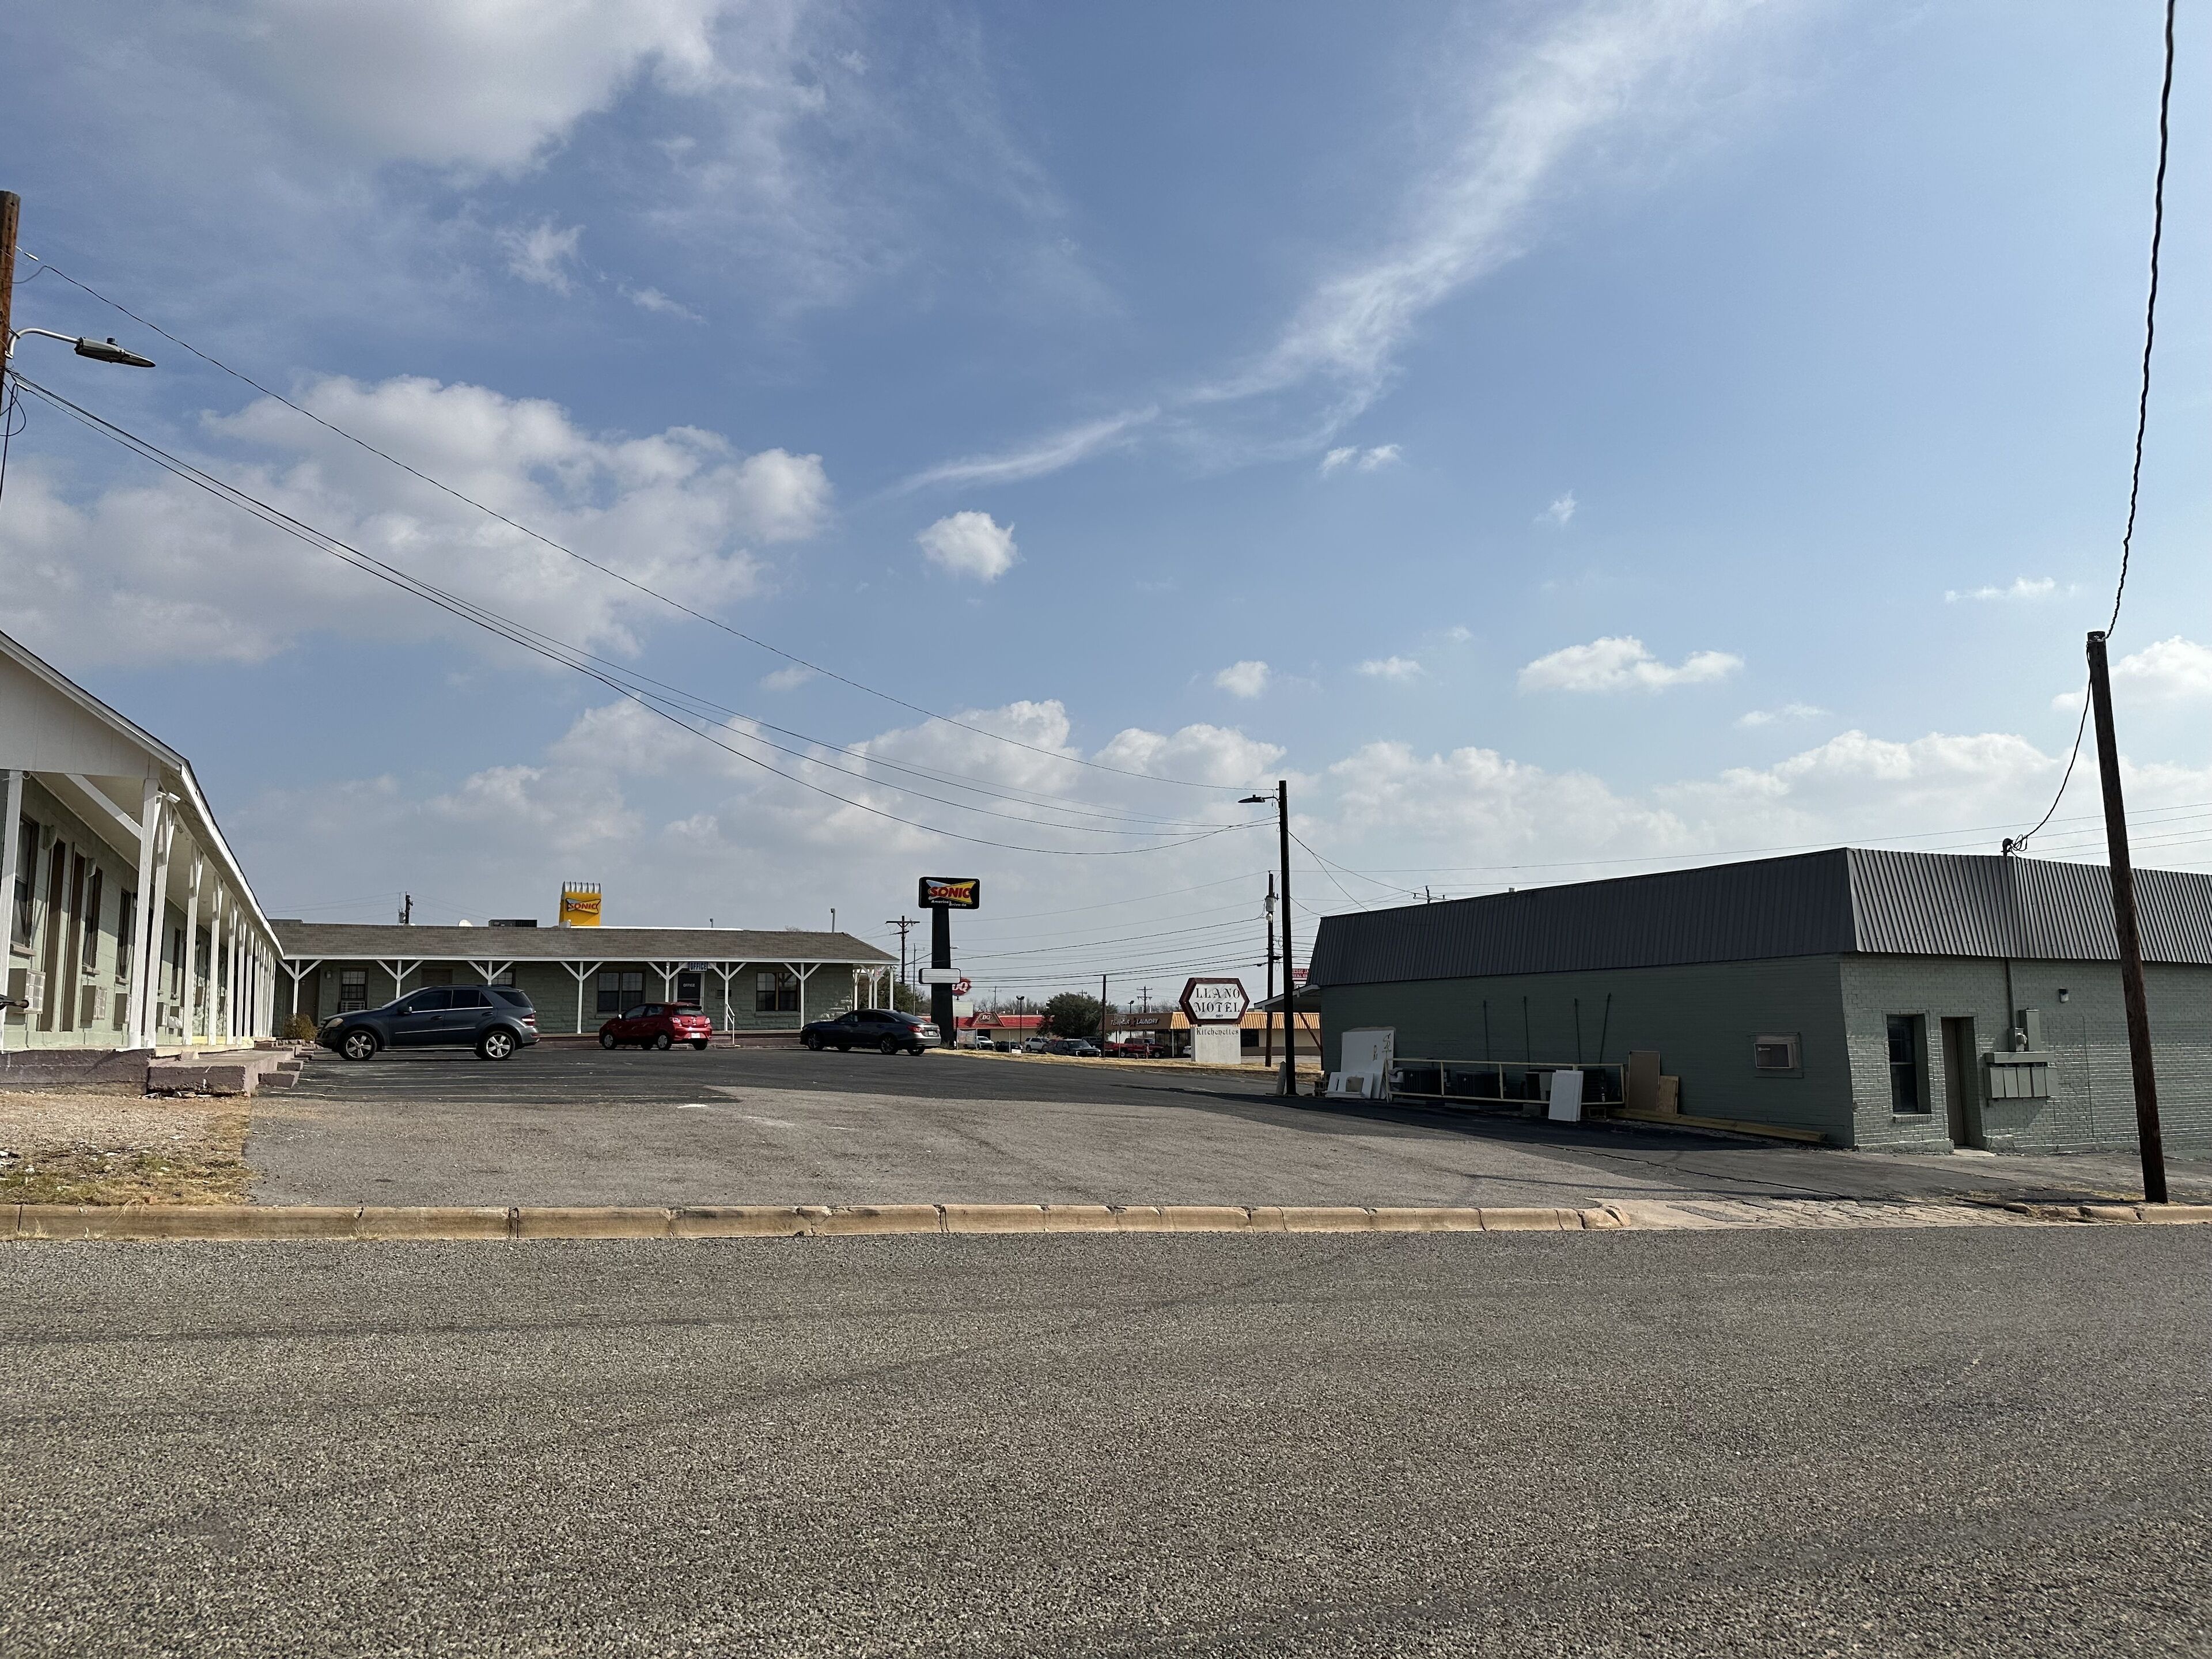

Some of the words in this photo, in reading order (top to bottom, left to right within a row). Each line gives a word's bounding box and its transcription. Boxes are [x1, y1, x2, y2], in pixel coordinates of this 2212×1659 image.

[929, 887, 971, 898] SONIC
[691, 962, 706, 971] OFFICE
[1196, 988, 1240, 999] LLANO
[1194, 1002, 1240, 1012] MOTEL
